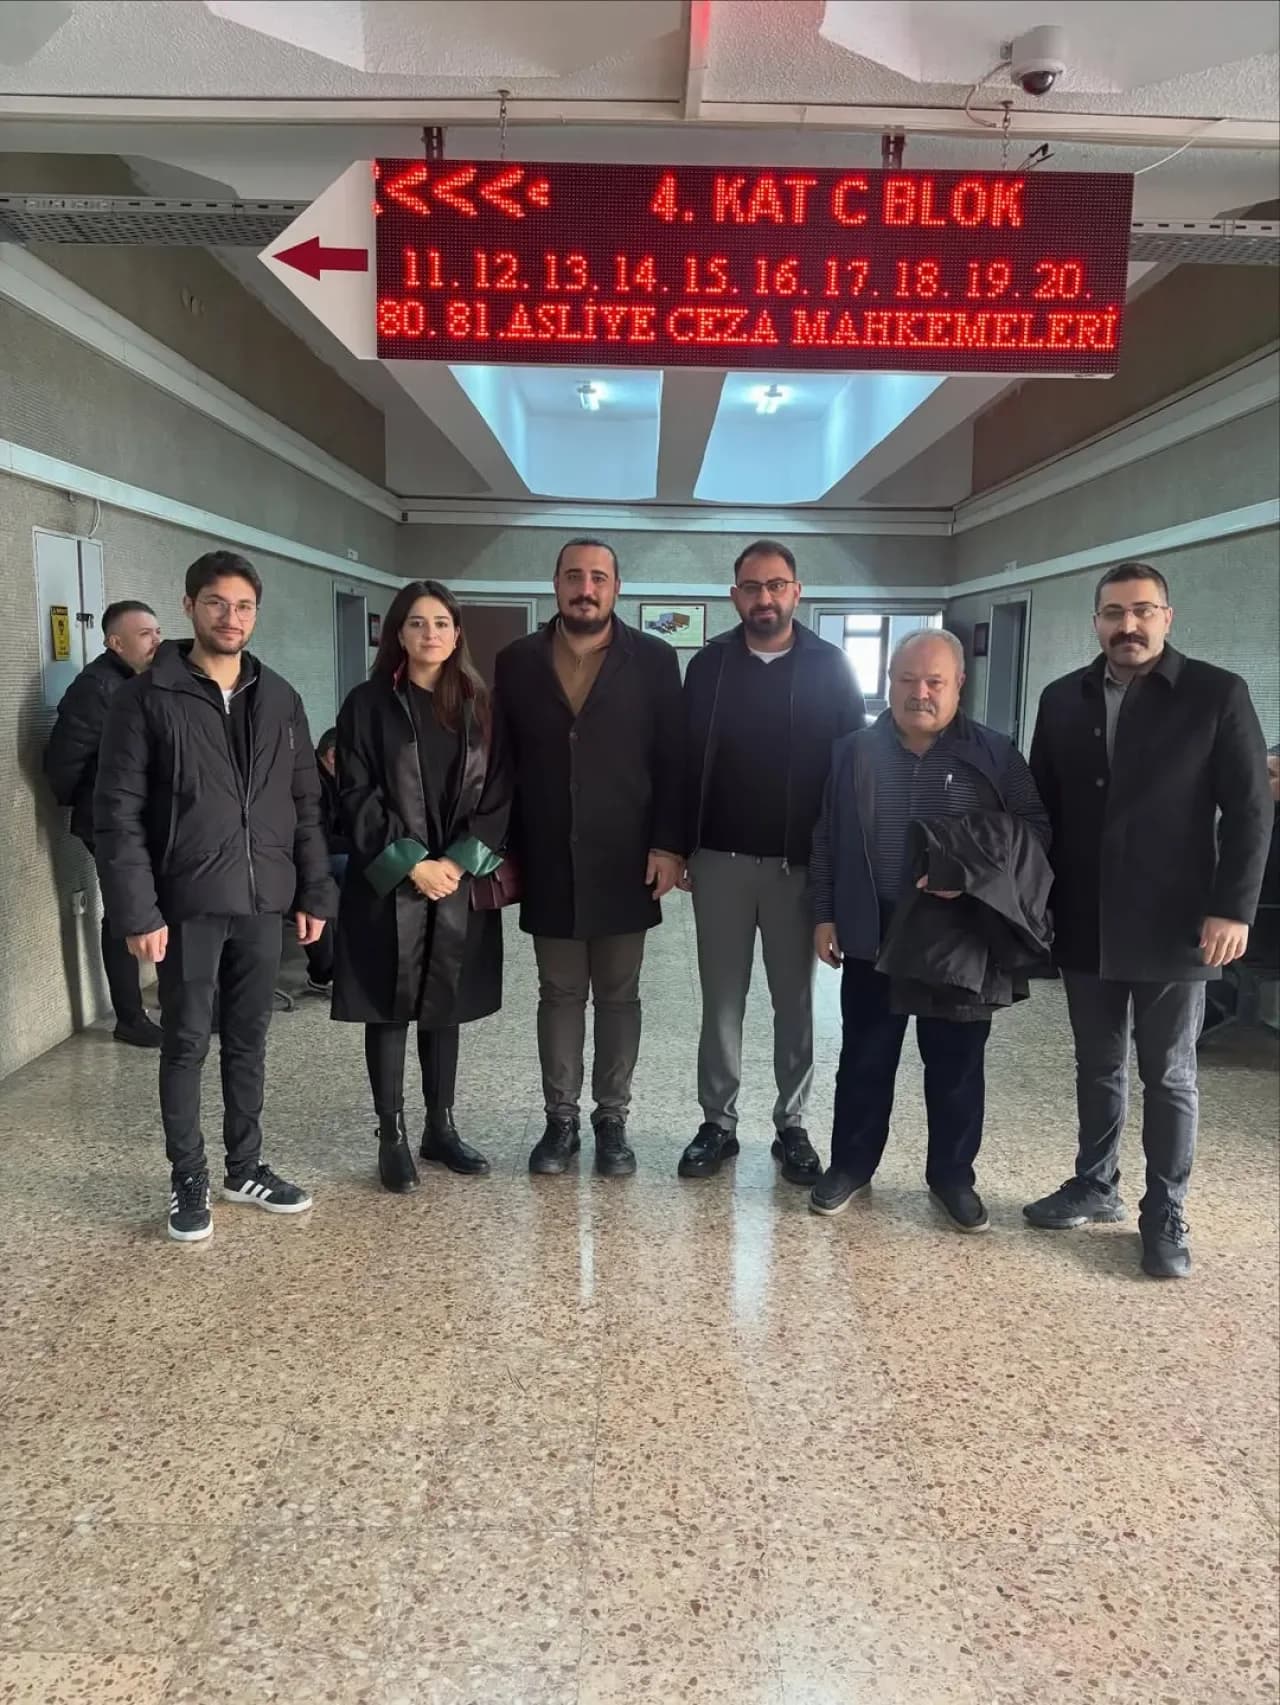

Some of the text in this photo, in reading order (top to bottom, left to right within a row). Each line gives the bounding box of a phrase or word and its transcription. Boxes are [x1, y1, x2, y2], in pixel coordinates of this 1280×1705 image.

[651, 173, 1024, 228] 4. KAT C BLOK
[403, 249, 1091, 299] 11. 12. 13. 14. 15. 16. 17. 18. 19. 20.
[378, 300, 436, 337] 80.
[667, 306, 779, 344] CEZA
[791, 304, 1117, 350] MAHKEMELERİ
